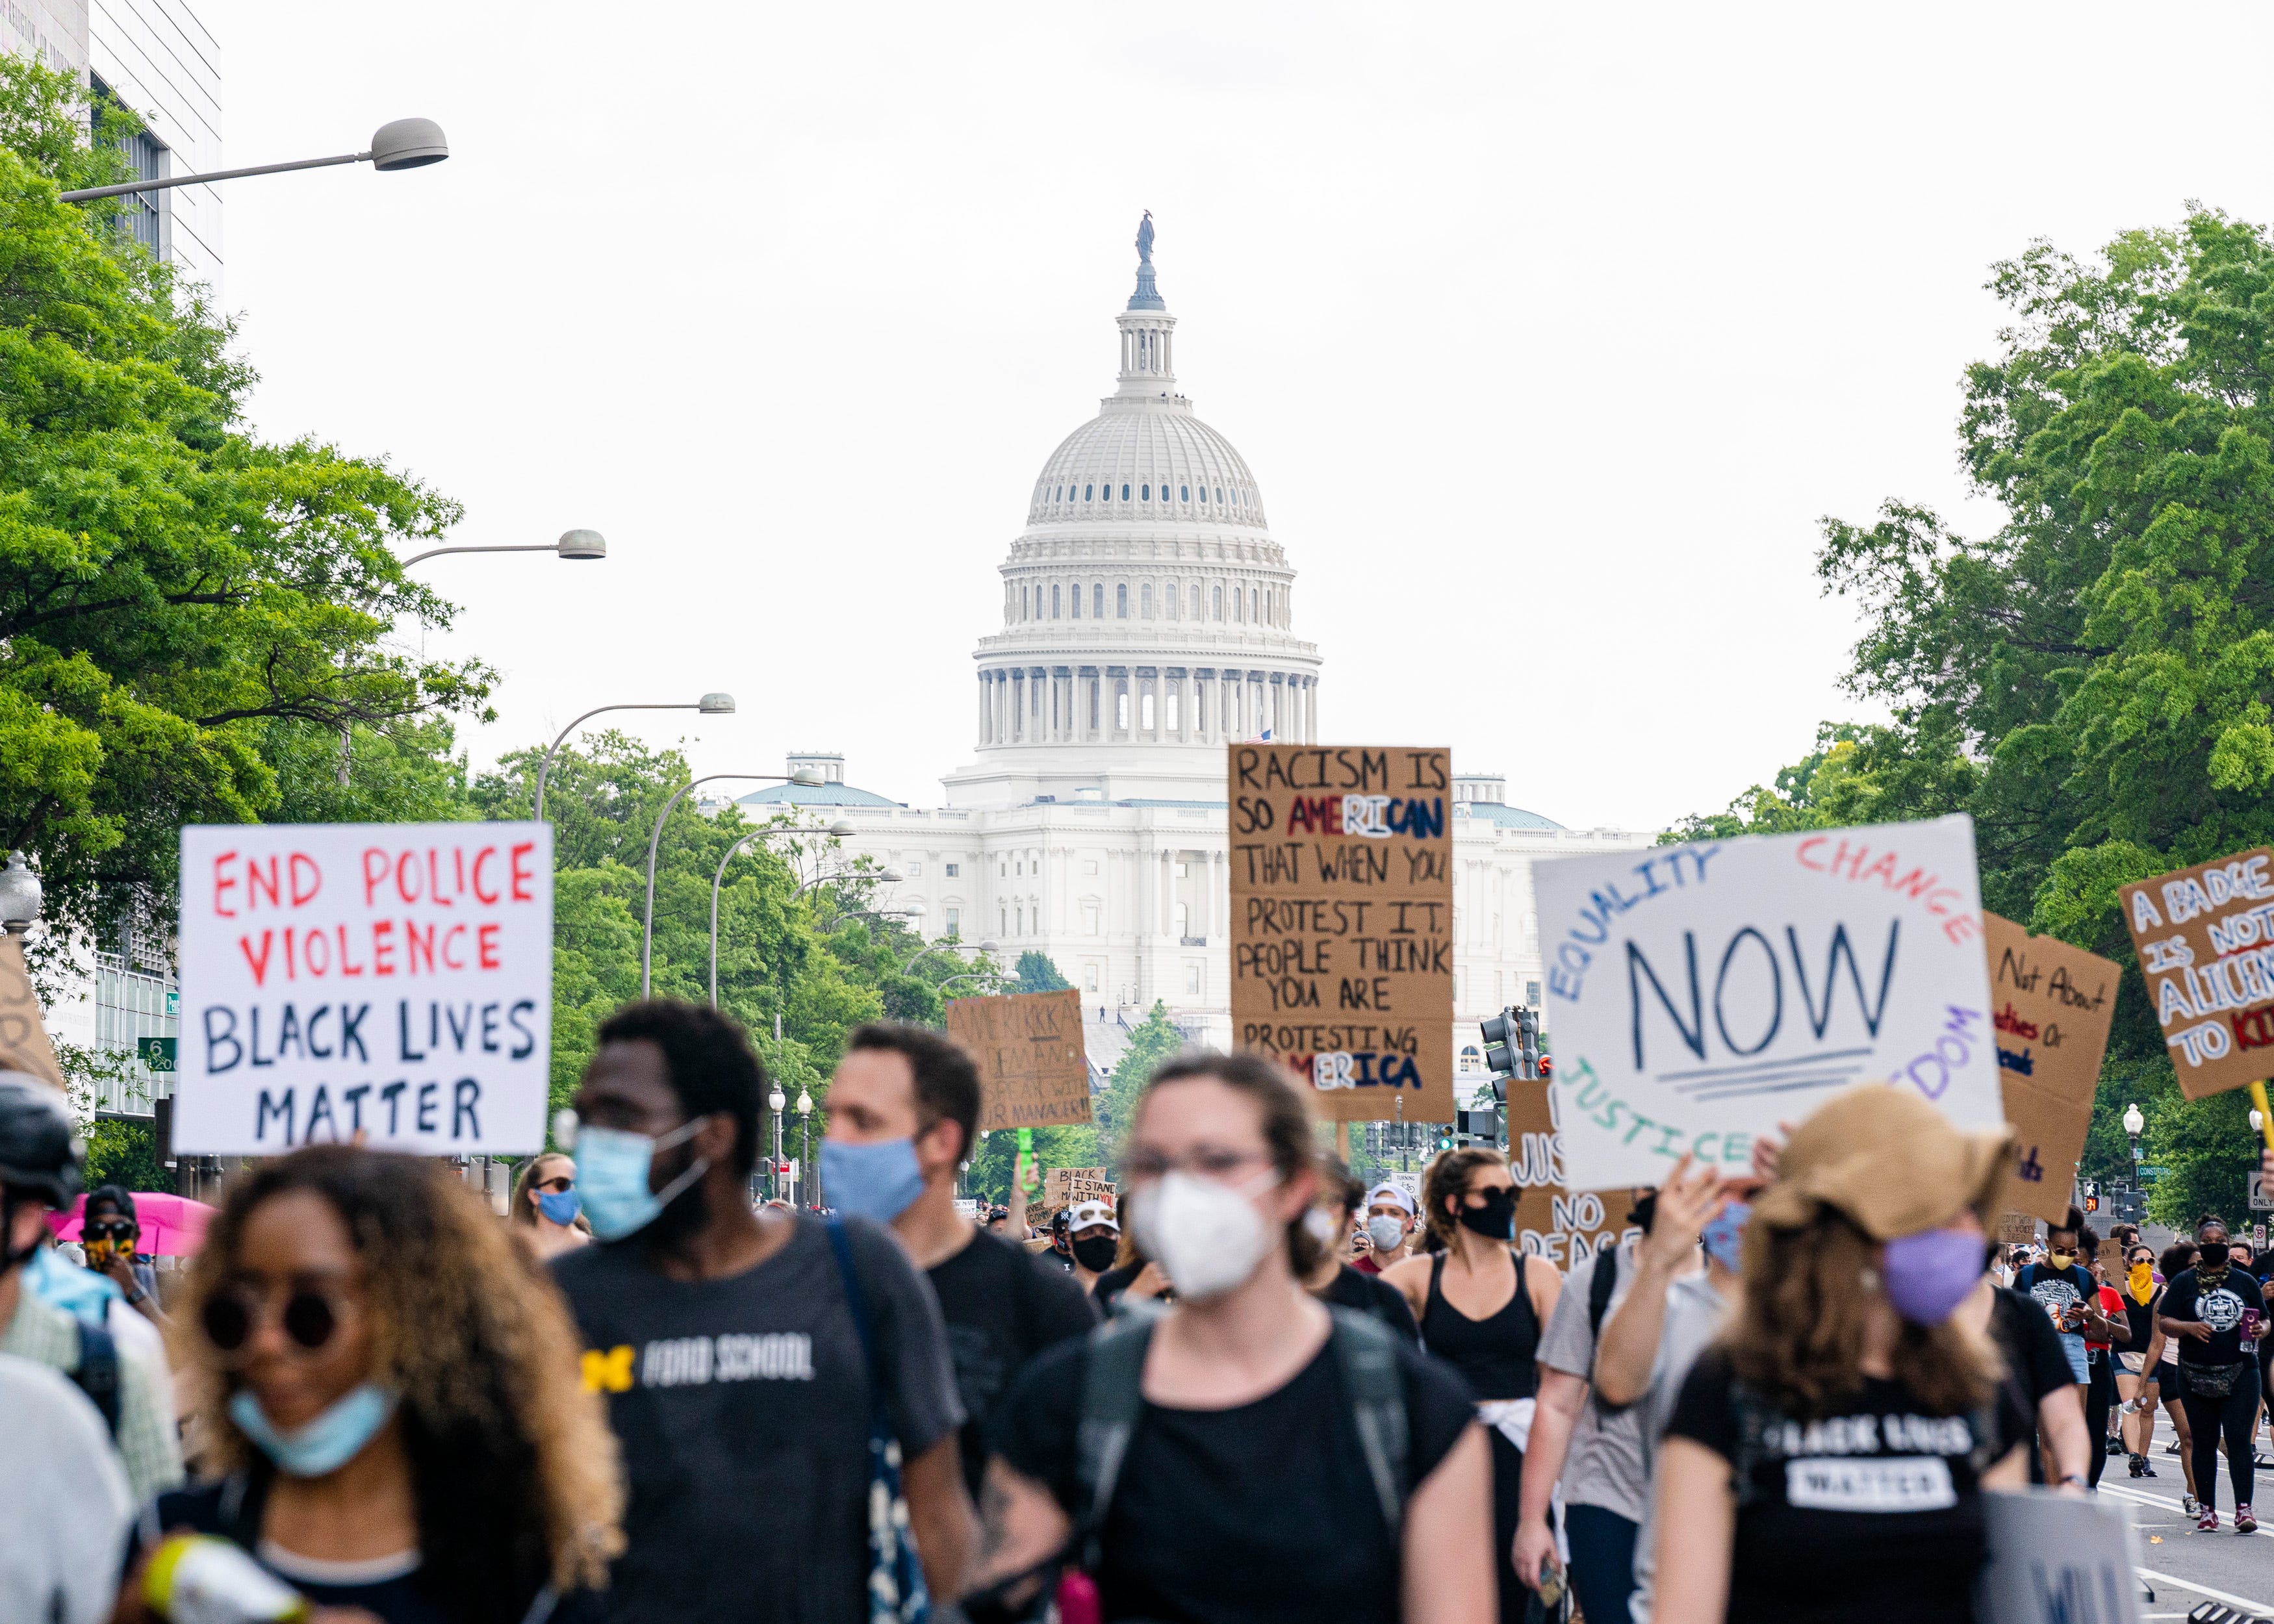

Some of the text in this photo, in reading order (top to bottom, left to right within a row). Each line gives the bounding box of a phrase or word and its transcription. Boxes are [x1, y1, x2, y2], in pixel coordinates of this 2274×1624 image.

[1238, 748, 1446, 791] RACISM IS
[1236, 794, 1444, 839] SO AMERICAN
[214, 843, 536, 918] END POLICE
[1235, 843, 1447, 885] THAT WHEN YOU
[1246, 896, 1372, 936] PROTEST
[2132, 855, 2274, 933] A BADGE
[1548, 835, 1984, 1003] EQUALITY CHANGE
[2142, 902, 2274, 974] IS NOT
[238, 918, 502, 988] VIOLENCE
[1236, 937, 1451, 978] PEOPLE THINK
[1266, 976, 1392, 1011] YOU ARE
[1624, 916, 1901, 1072] NOW
[1998, 946, 2107, 1013] Not About
[2158, 978, 2195, 1026] A
[150, 1040, 162, 1056] 6
[202, 998, 537, 1075] BLACK LIVES
[1244, 1023, 1418, 1056] PROTESTING
[2166, 1020, 2232, 1067] TO
[1273, 1050, 1422, 1091] MERICA
[255, 1076, 483, 1146] MATTER
[1557, 1054, 1752, 1163] JUSTICE
[1060, 1169, 1096, 1182] BLACK
[1072, 1191, 1099, 1202] WITH
[1073, 1180, 1082, 1189] I
[1084, 1180, 1116, 1195] STAND
[1552, 1193, 1605, 1232] NO
[2086, 1199, 2096, 1211] 34
